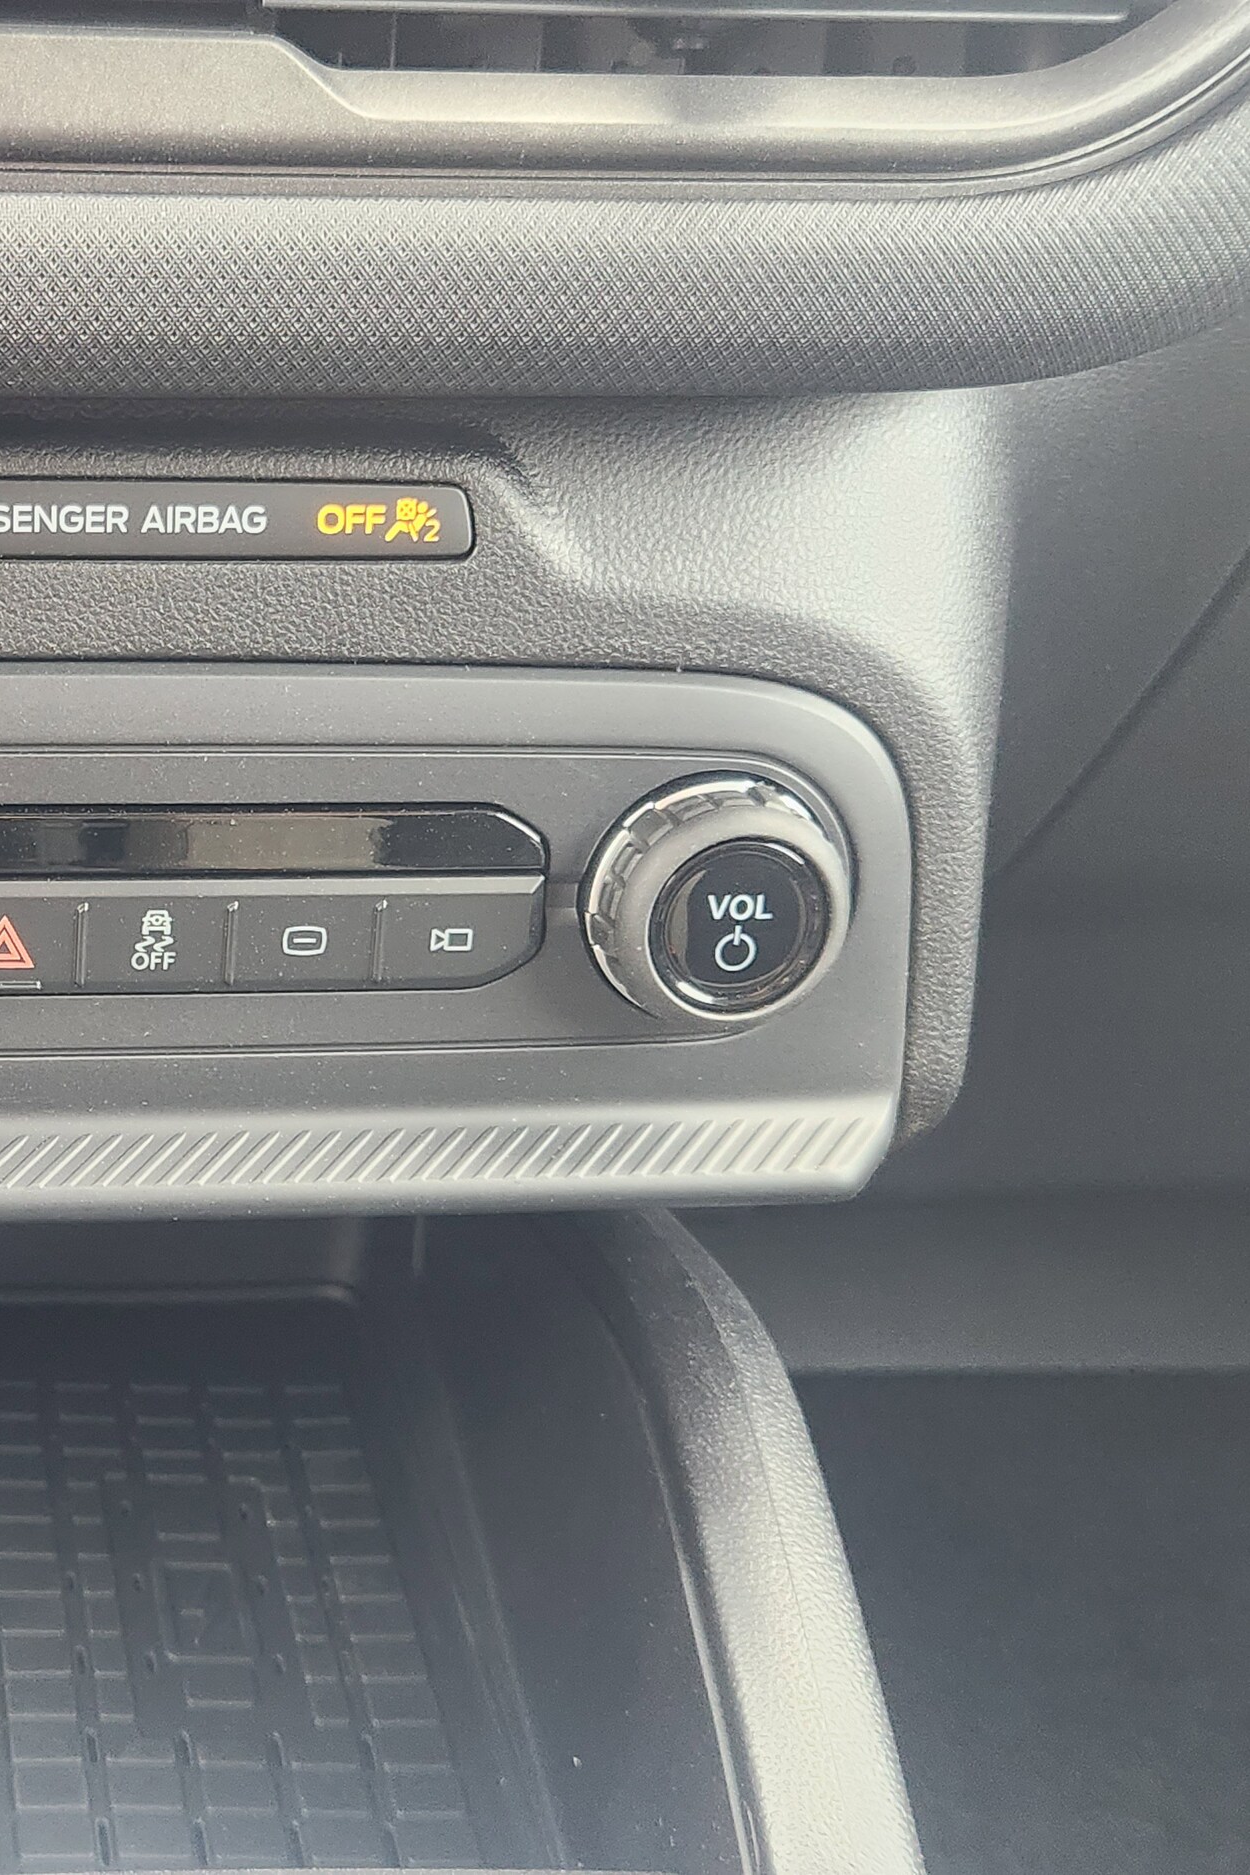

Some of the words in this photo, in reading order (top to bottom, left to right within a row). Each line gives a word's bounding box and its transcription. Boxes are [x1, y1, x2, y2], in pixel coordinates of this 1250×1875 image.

[140, 505, 268, 534] AIRBAG
[317, 503, 387, 535] OFF
[707, 893, 773, 921] VOL
[131, 951, 177, 971] OFF
